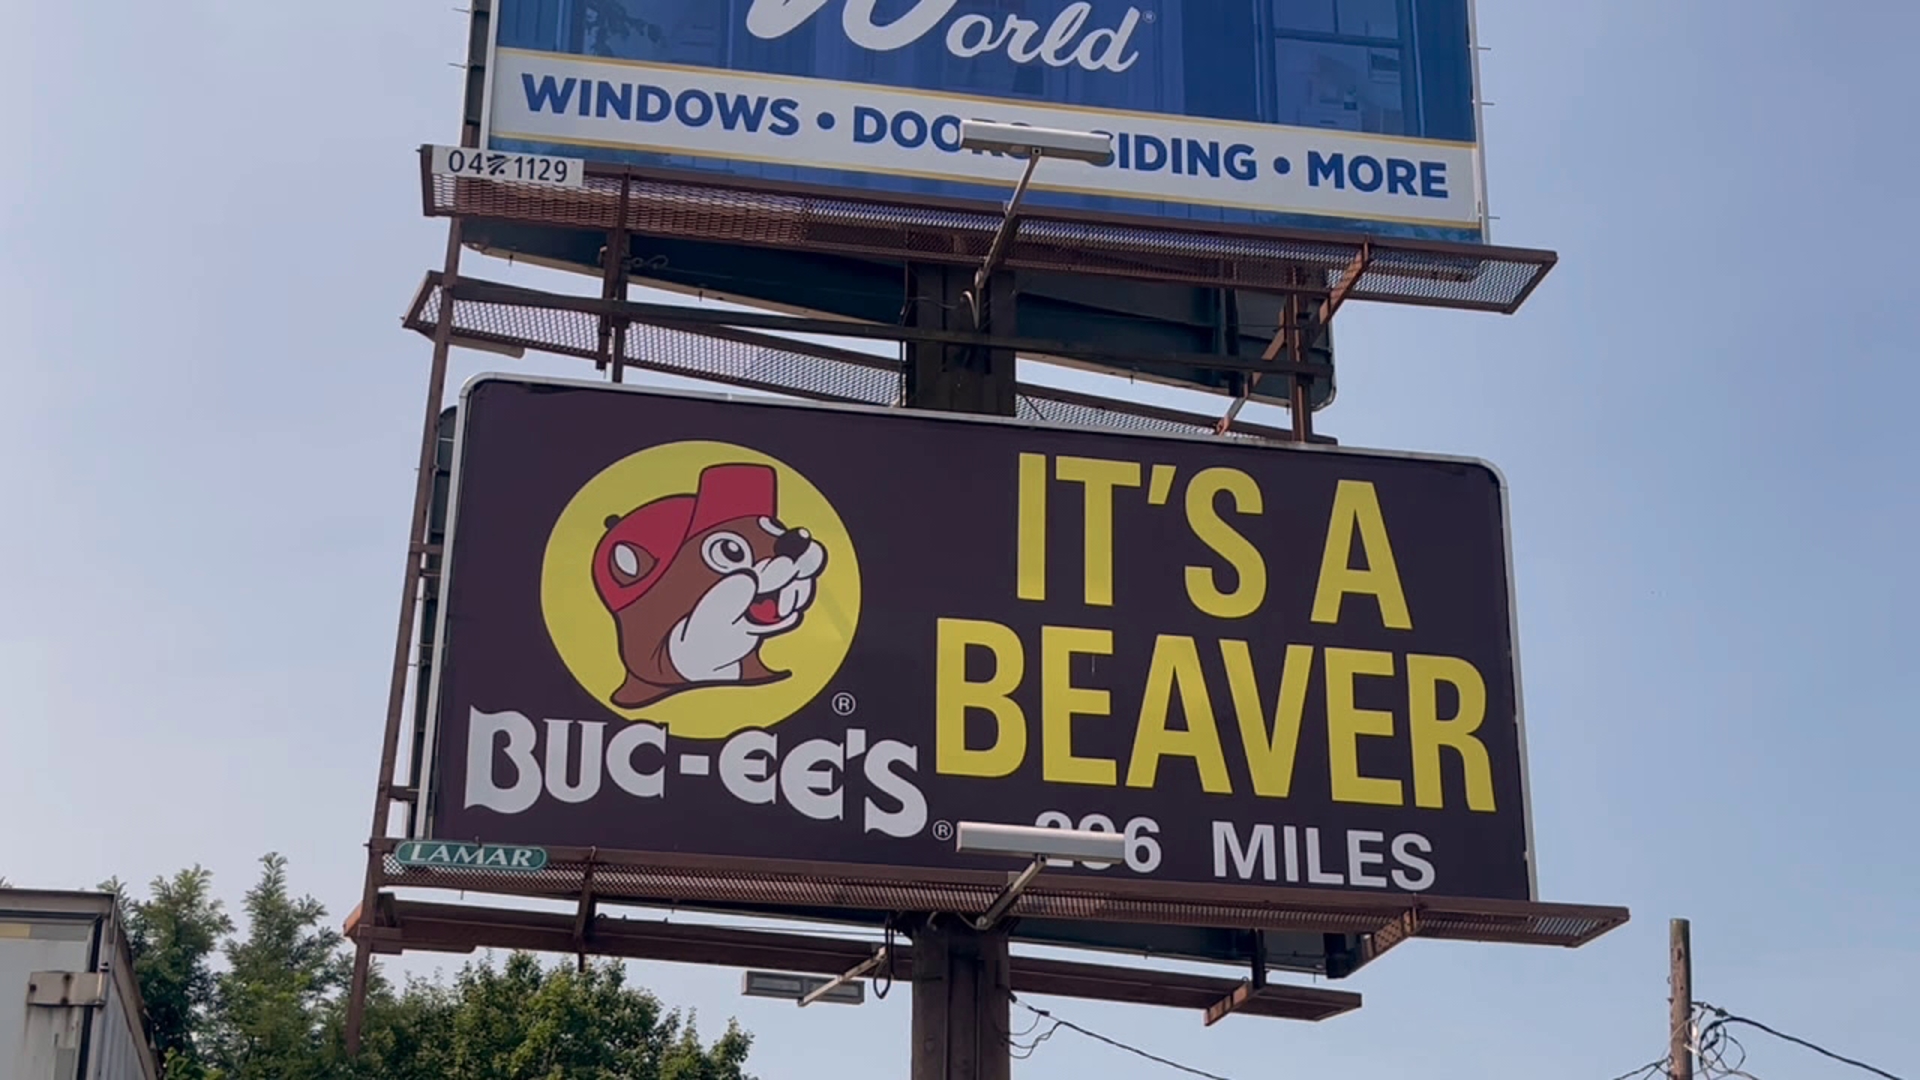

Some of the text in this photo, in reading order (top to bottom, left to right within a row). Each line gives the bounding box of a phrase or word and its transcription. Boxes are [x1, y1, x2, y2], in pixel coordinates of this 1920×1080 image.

[448, 150, 568, 183] 04 1129
[521, 72, 1449, 198] WINDOWS DOO IDING MORE
[1017, 452, 1413, 630] IT'S A
[935, 616, 1497, 812] BEAVER
[410, 842, 537, 868] LAMAR
[1212, 820, 1436, 891] MILES
